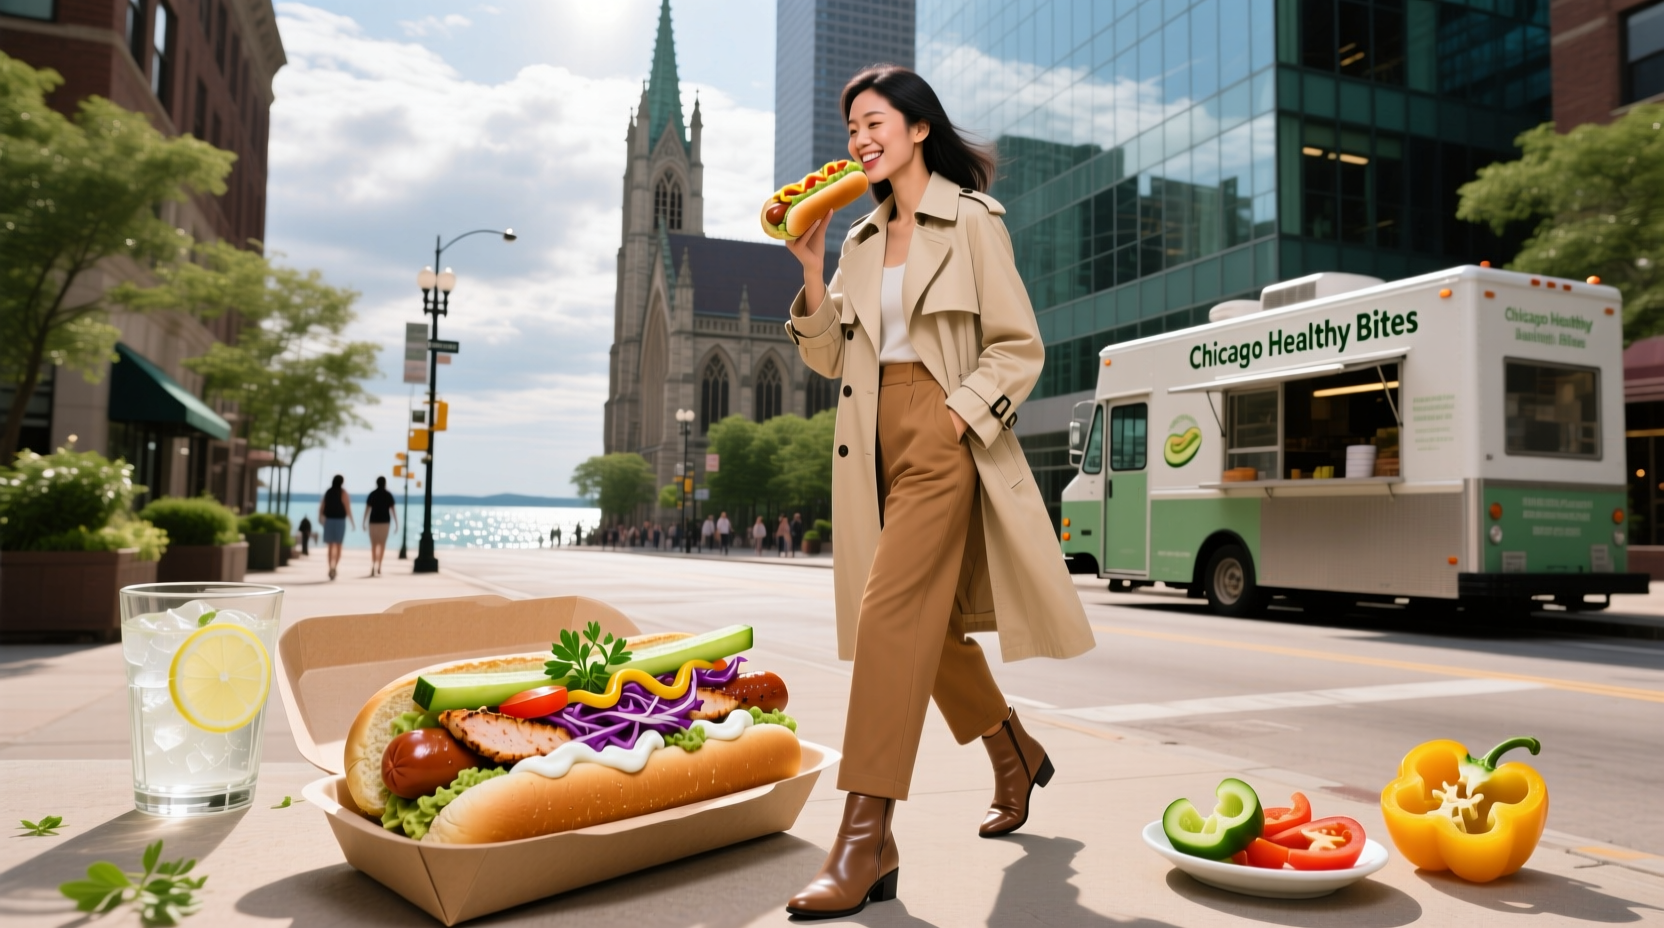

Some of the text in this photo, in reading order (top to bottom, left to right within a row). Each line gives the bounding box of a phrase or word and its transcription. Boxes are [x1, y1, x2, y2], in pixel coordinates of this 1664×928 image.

[1189, 309, 1418, 369] Chicago Healthy Bites
